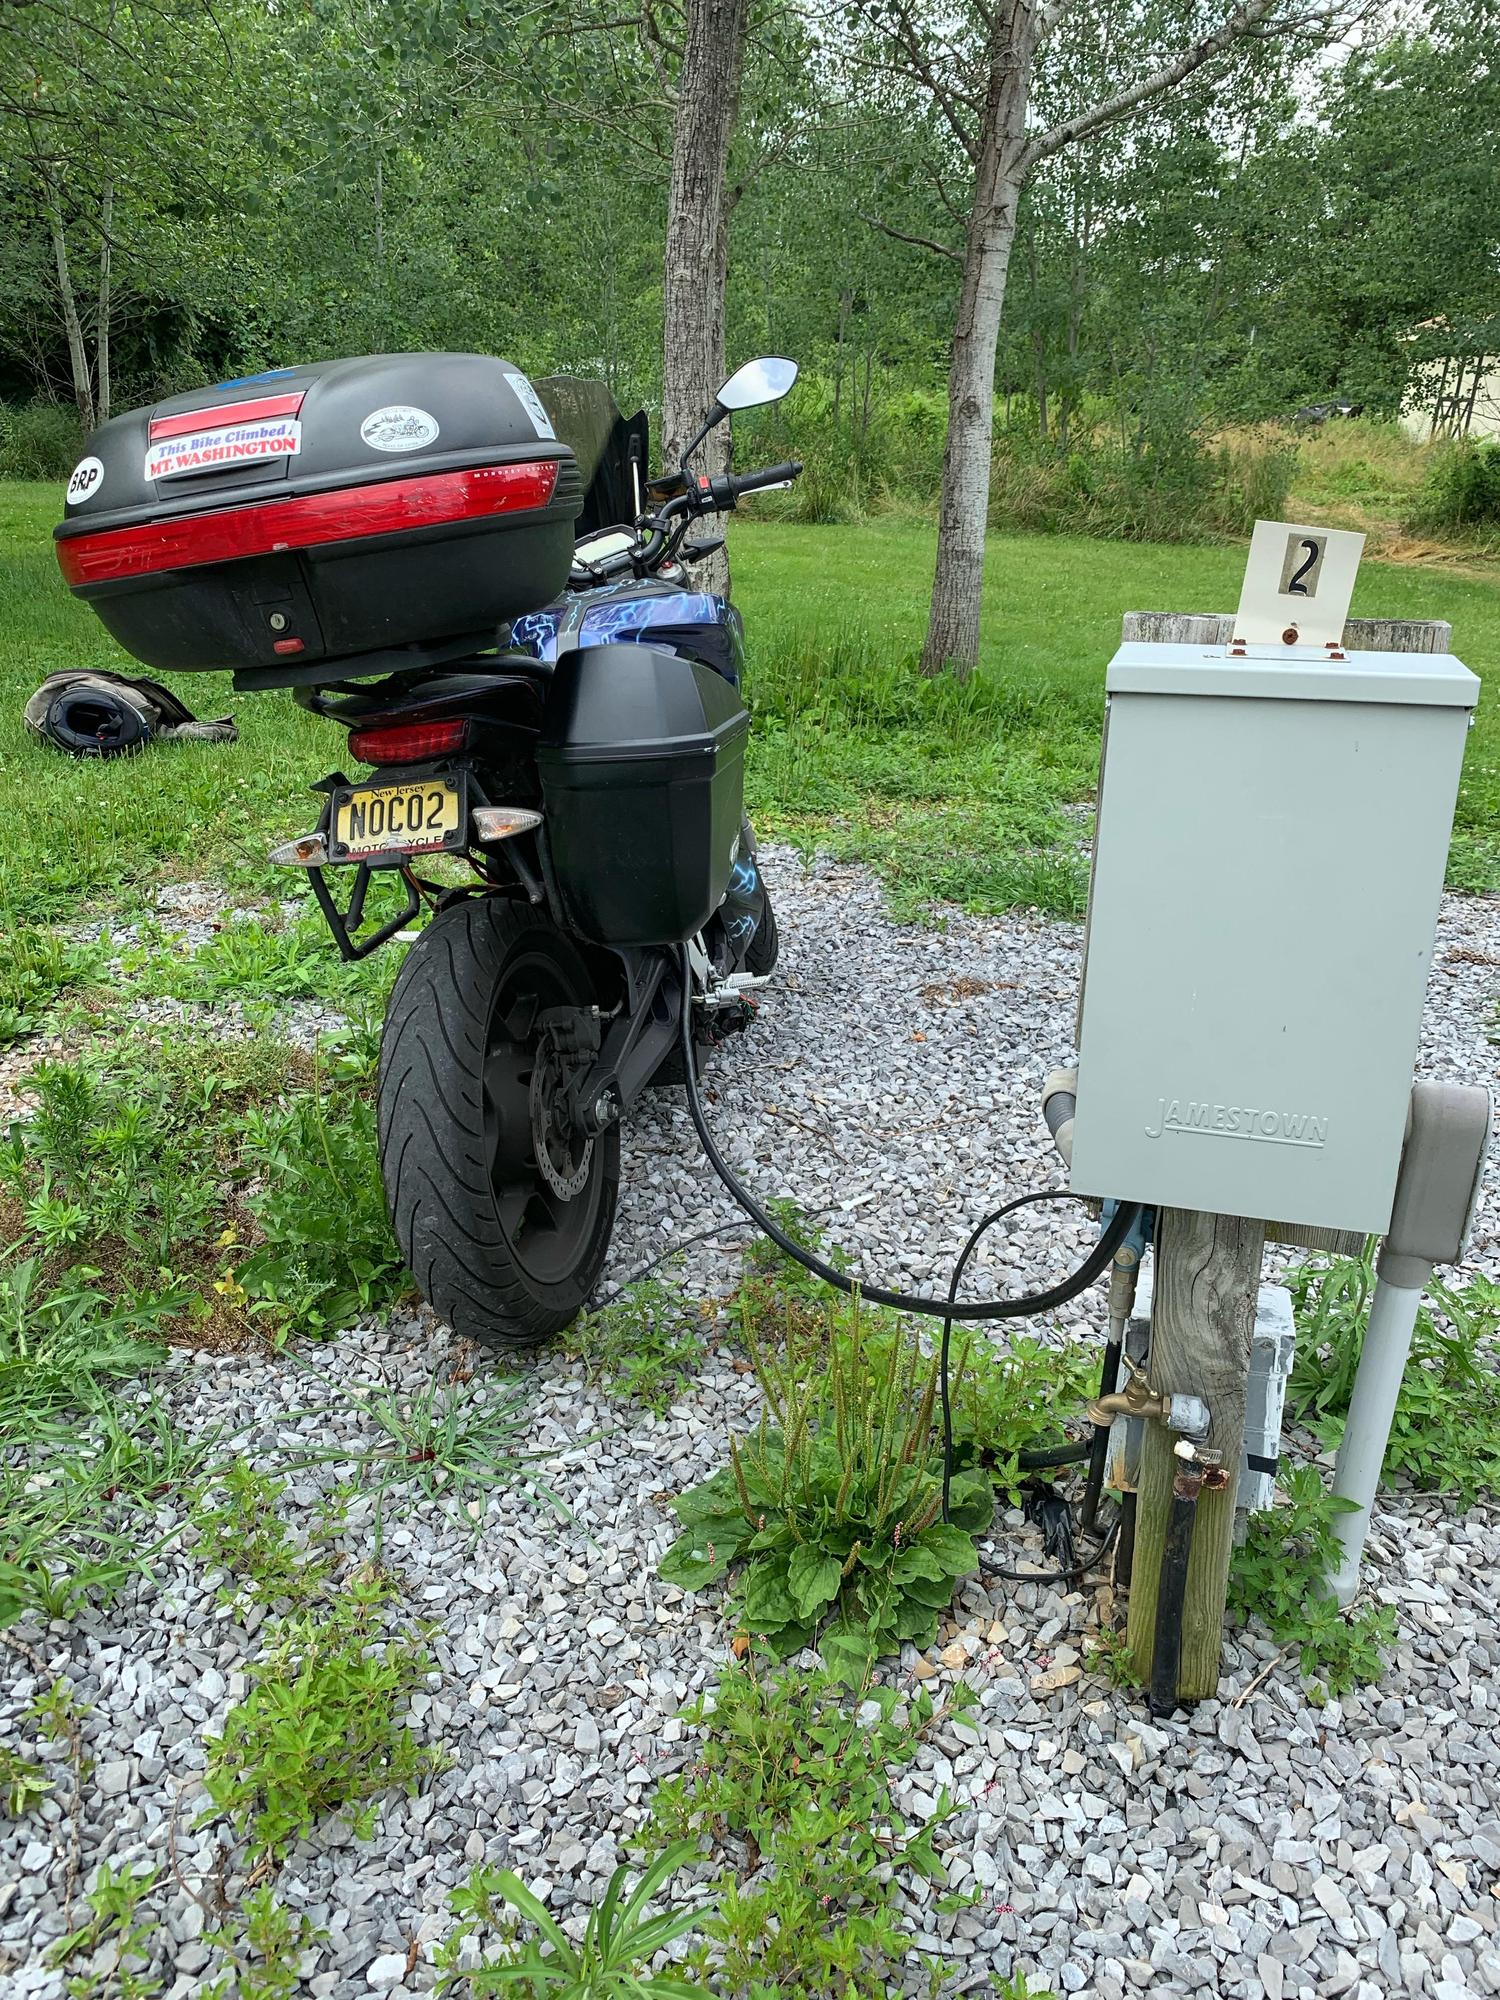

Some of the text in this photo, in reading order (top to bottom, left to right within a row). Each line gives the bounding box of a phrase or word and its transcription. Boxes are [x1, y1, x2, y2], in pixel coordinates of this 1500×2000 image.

[150, 438, 296, 477] MT. WASHINGTON
[158, 424, 287, 458] This Bike Climbed
[70, 468, 98, 493] BRP
[1288, 539, 1319, 593] 2
[371, 784, 427, 799] New Jersey
[1144, 1098, 1328, 1142] JAMESTOWN
